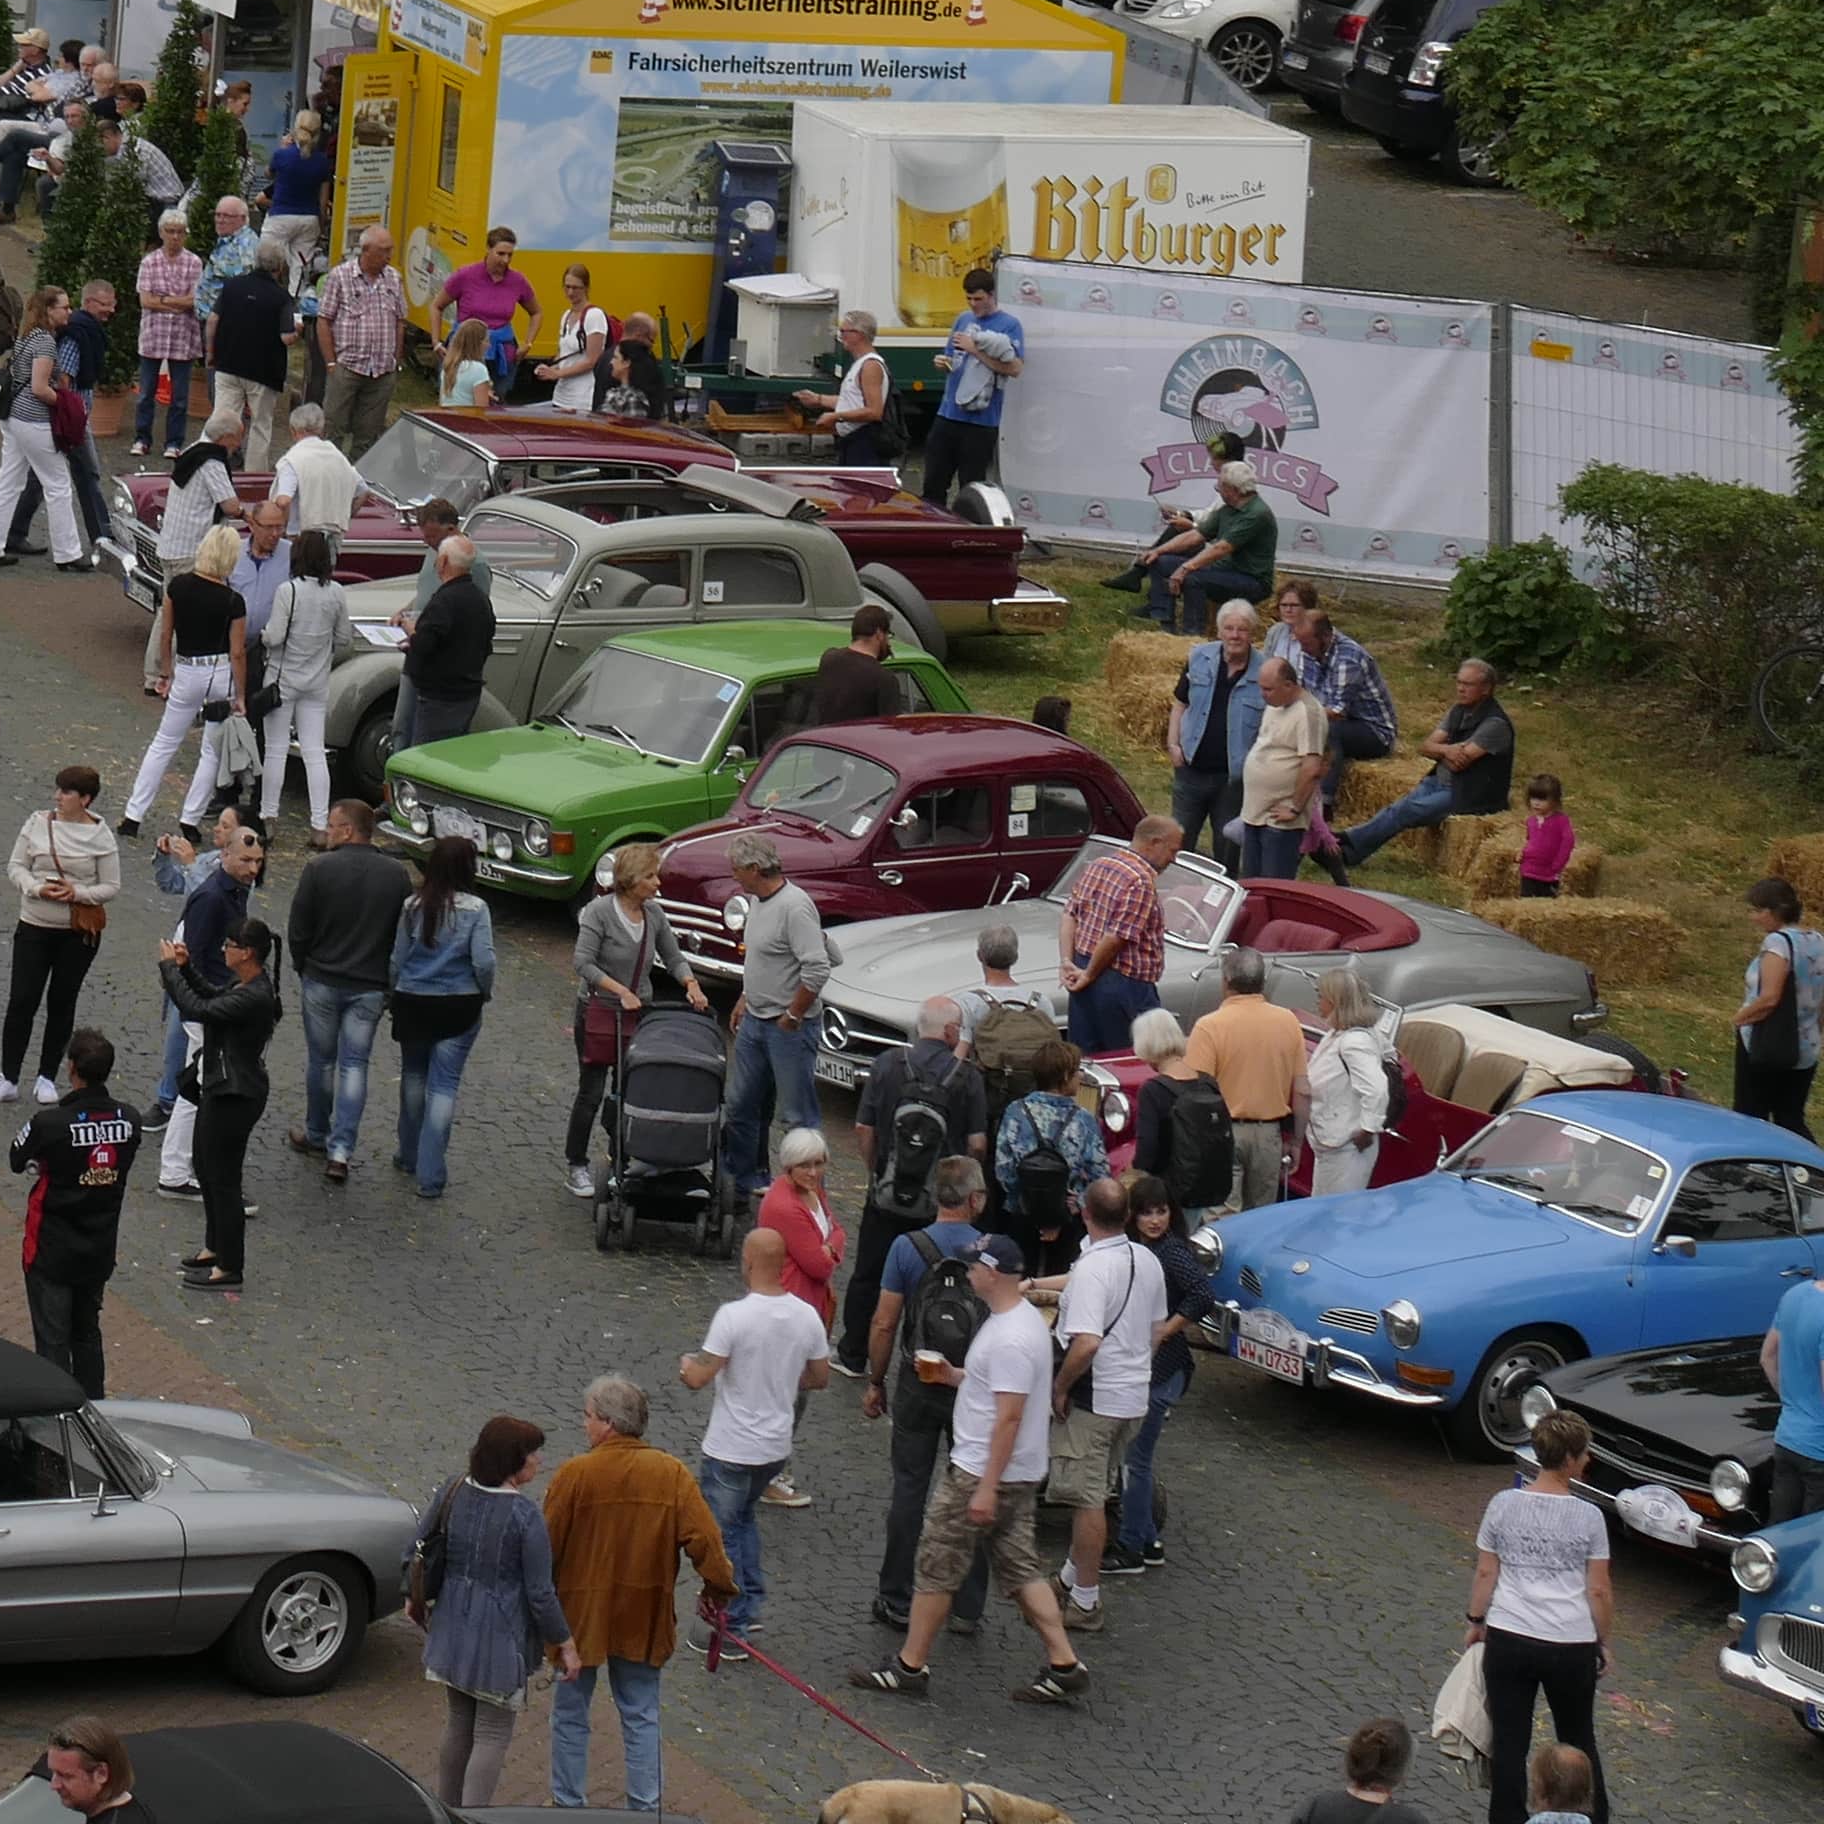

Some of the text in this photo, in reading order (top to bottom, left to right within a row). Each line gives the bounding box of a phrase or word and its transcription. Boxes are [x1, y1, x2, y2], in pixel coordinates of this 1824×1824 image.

[628, 51, 967, 81] Fahrsicherheitszentrum Weilerswist
[612, 221, 675, 234] schonend
[1031, 174, 1287, 277] Bitburger
[1165, 338, 1314, 425] RHEINBACH
[1167, 450, 1310, 489] CLASICS
[1264, 1349, 1301, 1376] 0733
